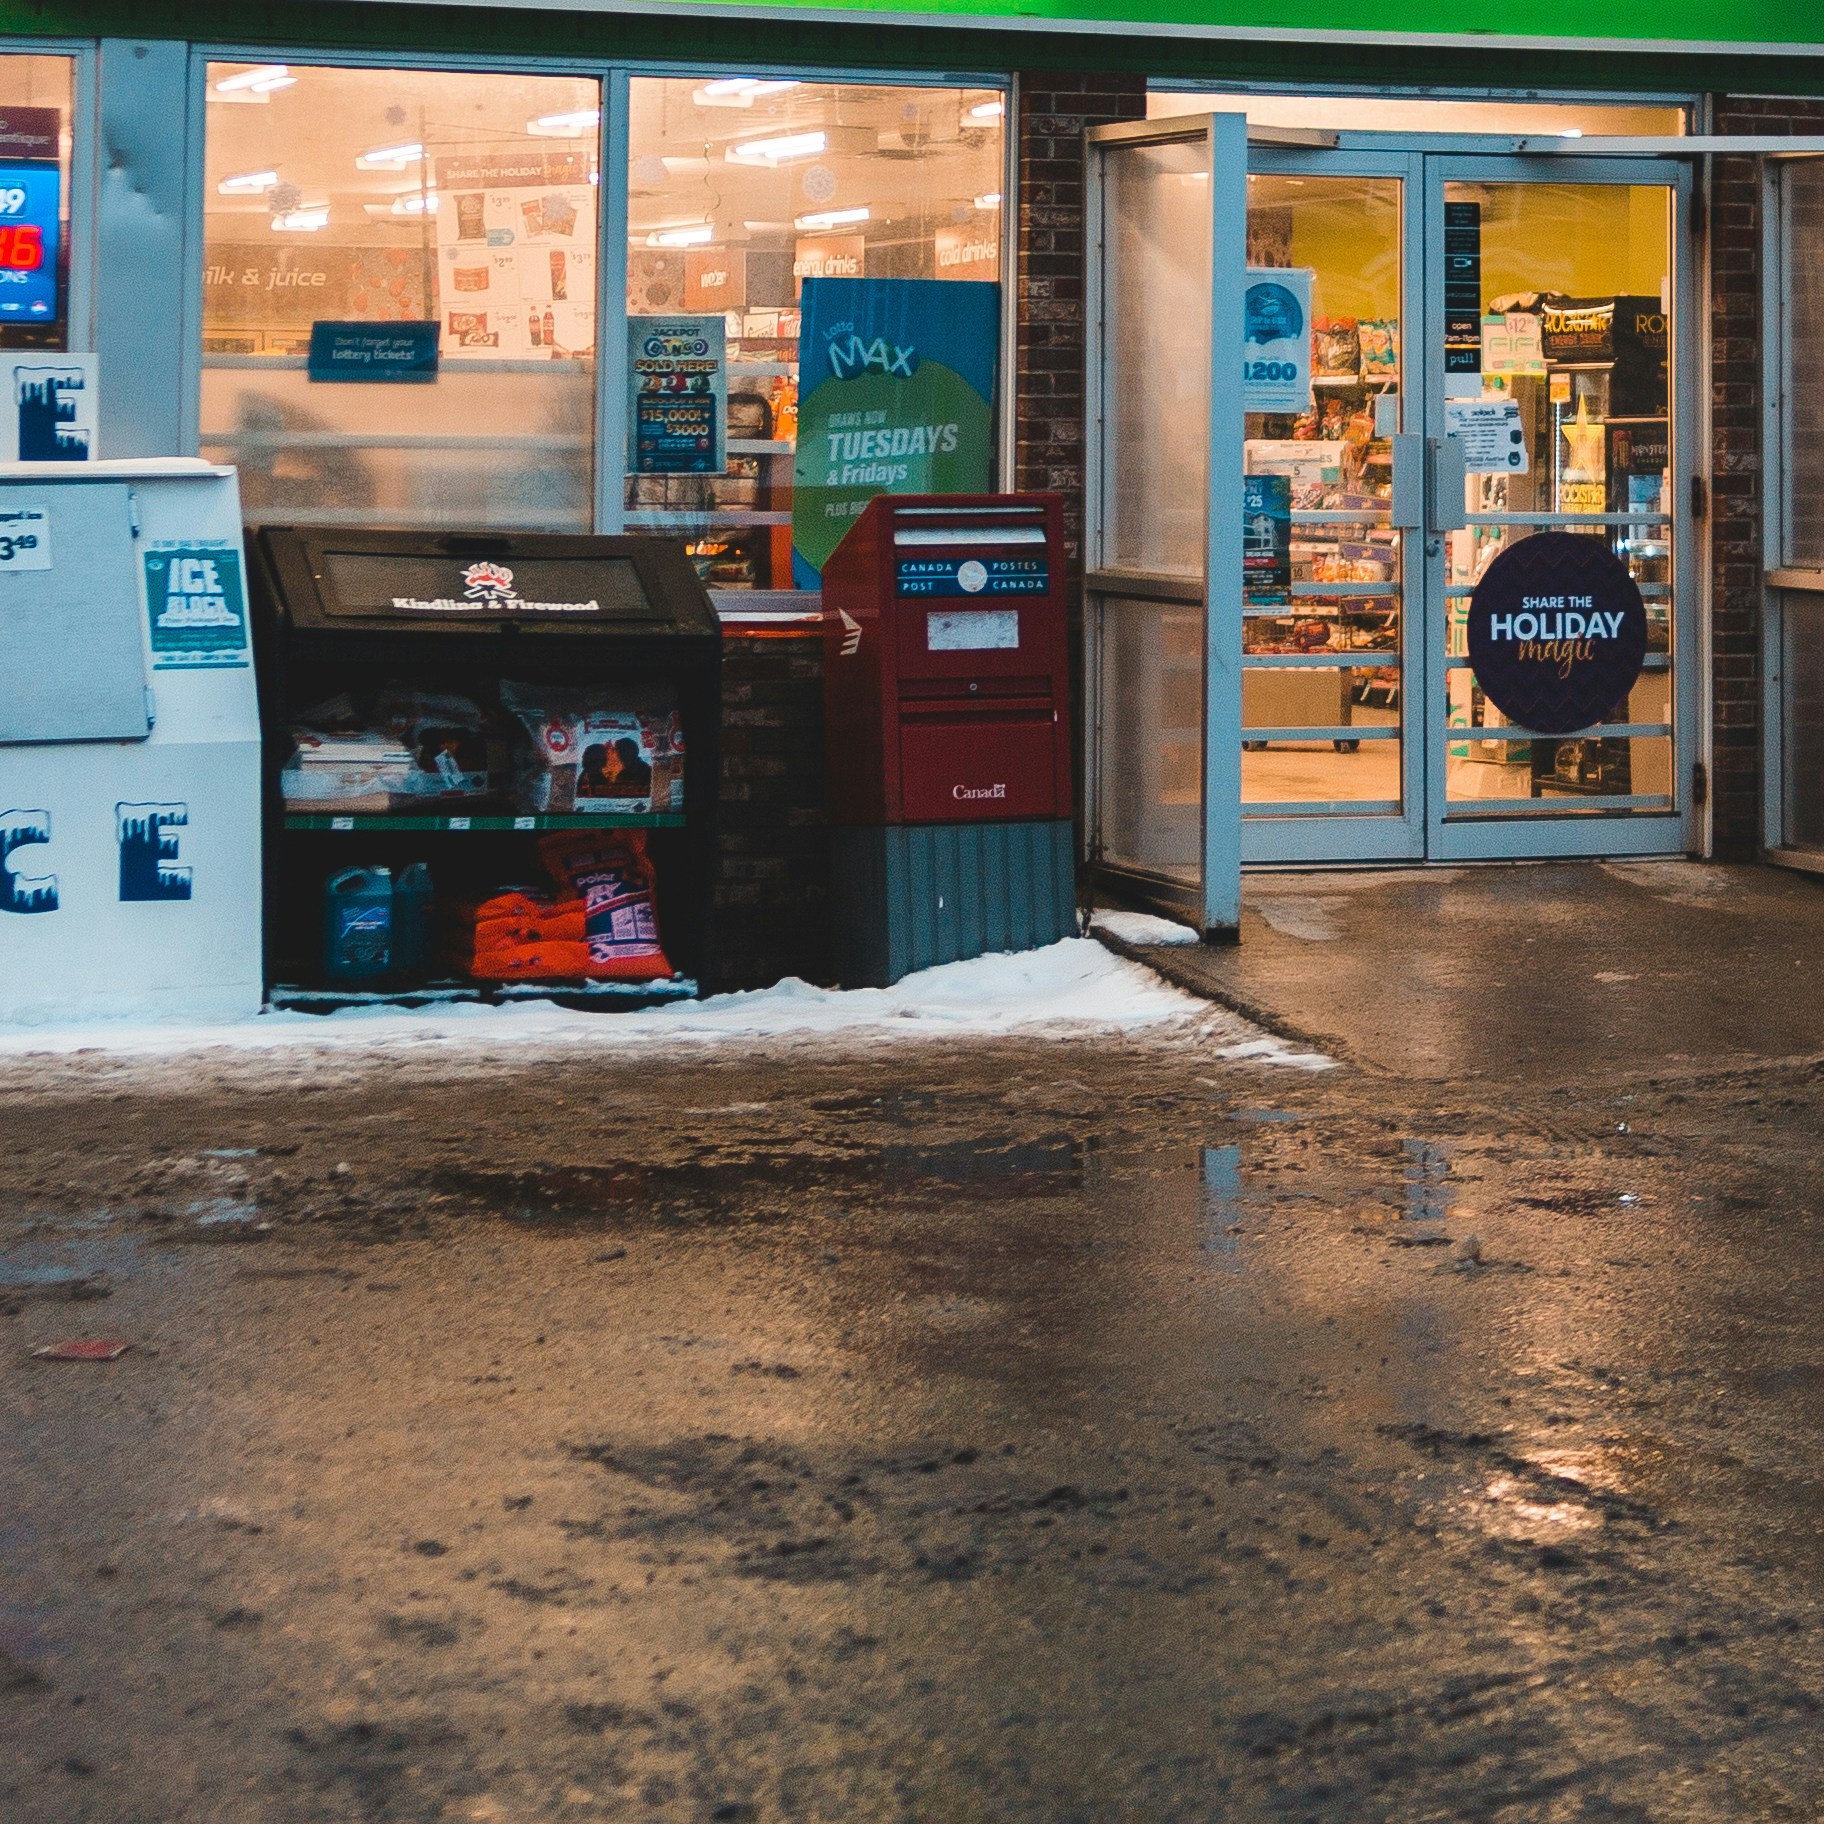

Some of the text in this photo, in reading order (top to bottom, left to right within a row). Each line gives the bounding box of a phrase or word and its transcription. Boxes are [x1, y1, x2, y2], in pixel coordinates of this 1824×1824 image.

[447, 168, 479, 179] SHARE
[480, 168, 499, 178] THE
[501, 167, 543, 178] HOLIDAY
[939, 240, 997, 267] cold drinks
[793, 255, 857, 277] energy drinks
[242, 268, 260, 285] &
[265, 266, 327, 291] juice
[651, 328, 701, 337] JACKPOT
[1451, 322, 1472, 332] open
[334, 336, 416, 352] Don't forget your
[332, 348, 416, 363] lottery tickets!
[828, 335, 915, 378] MAX
[1449, 352, 1475, 366] pull
[635, 360, 674, 373] SOLD
[828, 423, 959, 462] TUESDAYS
[827, 462, 908, 486] & Fridays
[901, 562, 953, 573] CANADA
[992, 561, 1038, 572] POSTES
[167, 558, 224, 593] ICE
[902, 581, 933, 592] POST
[992, 578, 1045, 589] CANADA
[392, 597, 601, 612] Kindling & Firewood
[1522, 595, 1593, 609] SHARE THE
[1490, 611, 1625, 641] HOLIDAY
[1517, 631, 1597, 680] magic
[952, 783, 1006, 799] Canada
[576, 872, 616, 888] polar
